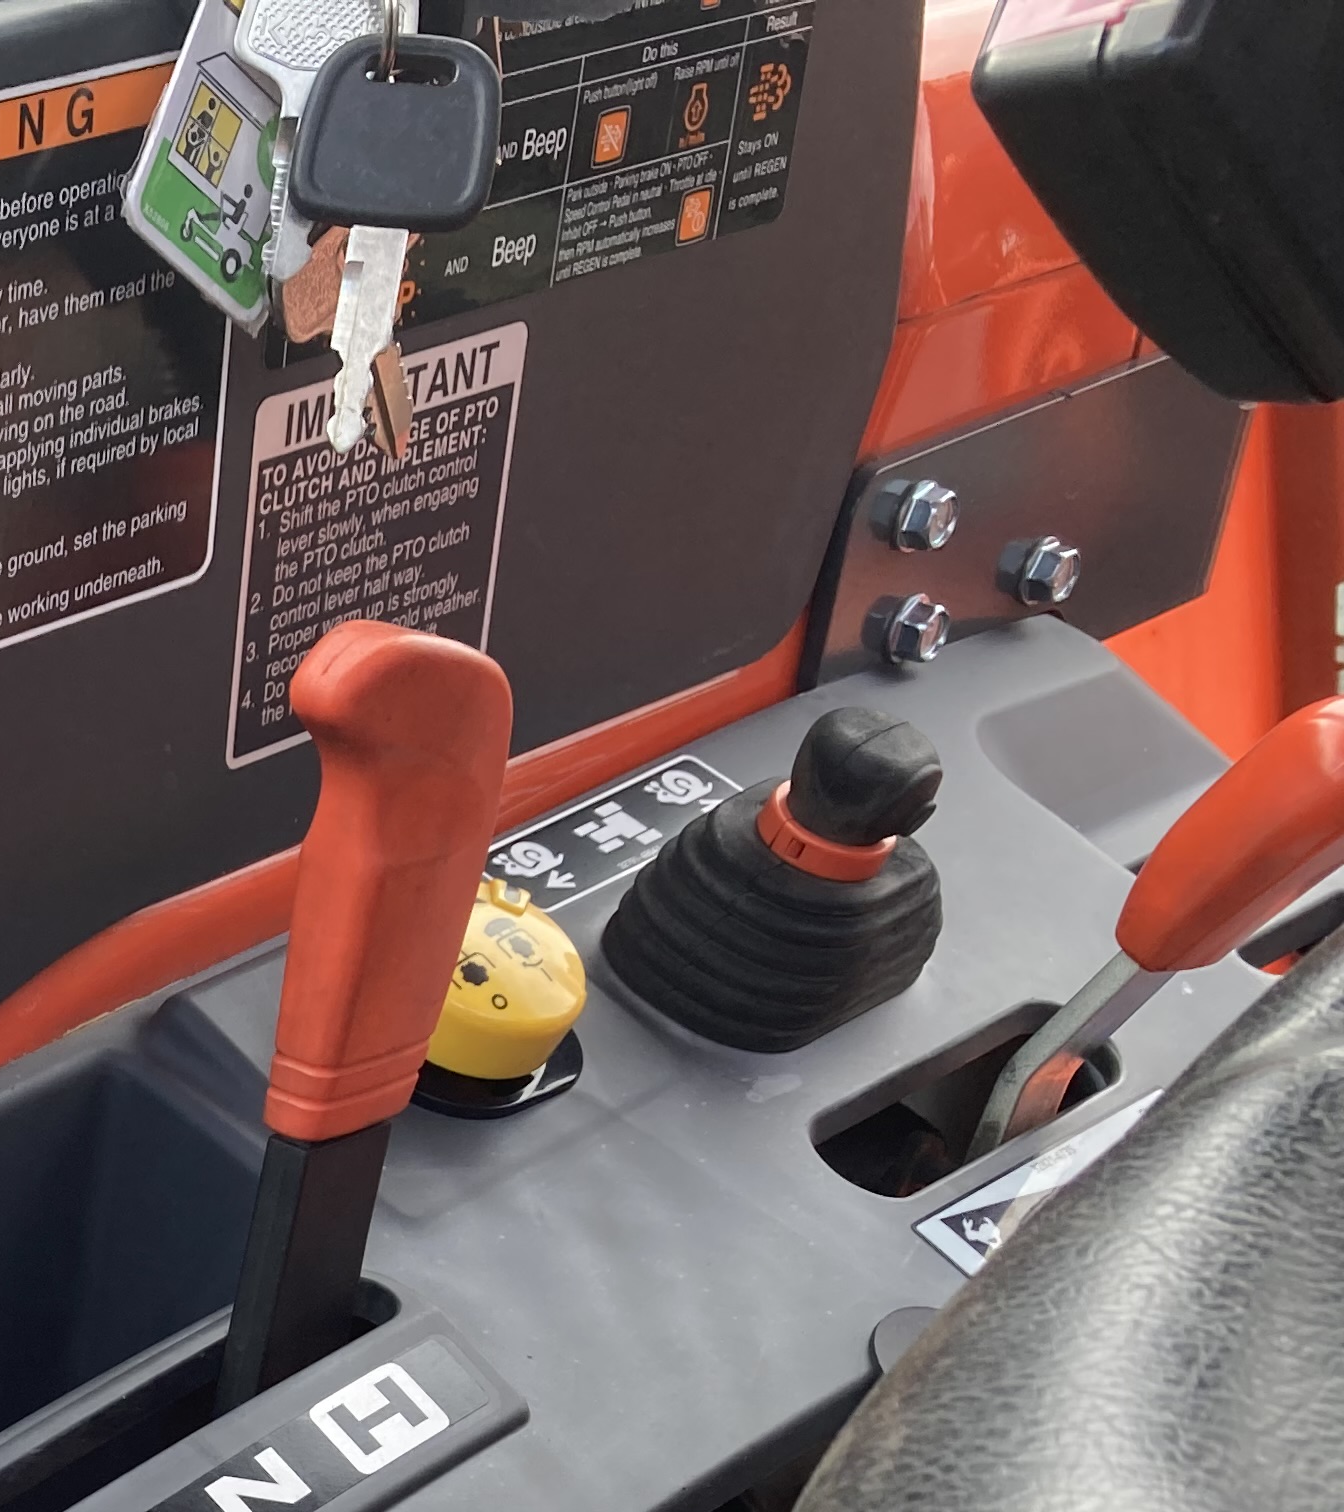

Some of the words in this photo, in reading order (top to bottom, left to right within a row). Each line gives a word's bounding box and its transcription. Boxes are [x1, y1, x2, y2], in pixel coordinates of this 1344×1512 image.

[766, 10, 799, 33] Result
[642, 46, 658, 63] Do
[659, 41, 679, 59] this
[522, 127, 567, 161] Beep
[737, 139, 762, 156] Stays
[763, 131, 779, 148] ON
[732, 165, 753, 184] until
[753, 155, 788, 177] REGEN
[728, 198, 737, 211] is
[737, 186, 779, 208] complete.
[444, 256, 469, 277] AND
[492, 233, 537, 267] Beep
[8, 279, 48, 304] time.
[262, 463, 287, 490] TO
[435, 407, 461, 435] OF
[463, 395, 499, 426] PTO
[258, 519, 271, 540] 1.
[279, 503, 314, 534] Shift
[317, 498, 341, 521] the
[344, 481, 380, 512] PTO
[382, 467, 426, 499] clutch
[428, 448, 478, 485] control
[259, 471, 334, 516] CLUTCH
[337, 458, 377, 491] AND
[276, 530, 315, 558] lever
[317, 512, 366, 545] slowly,
[371, 499, 411, 526] when
[413, 476, 480, 512] engaging
[249, 592, 264, 615] 2.
[272, 584, 295, 607] Do
[298, 572, 322, 597] not
[325, 562, 362, 588] keep
[365, 553, 389, 575] the
[391, 536, 426, 566] PTO
[428, 521, 470, 553] clutch
[274, 560, 298, 583] the
[302, 542, 338, 573] PTO
[340, 527, 387, 560] clutch.
[7, 589, 70, 624] working
[74, 556, 165, 601] underneath.
[269, 594, 321, 631] control
[323, 585, 361, 612] lever
[363, 570, 391, 598] half
[393, 564, 425, 587] way.
[363, 600, 384, 625] up
[387, 592, 400, 612] is
[403, 571, 459, 607] strongly
[423, 588, 480, 621] weather.
[245, 641, 259, 663] 3.
[268, 623, 319, 655] Proper
[241, 689, 255, 710] 4.
[263, 681, 286, 703] Do
[335, 1373, 429, 1453] H
